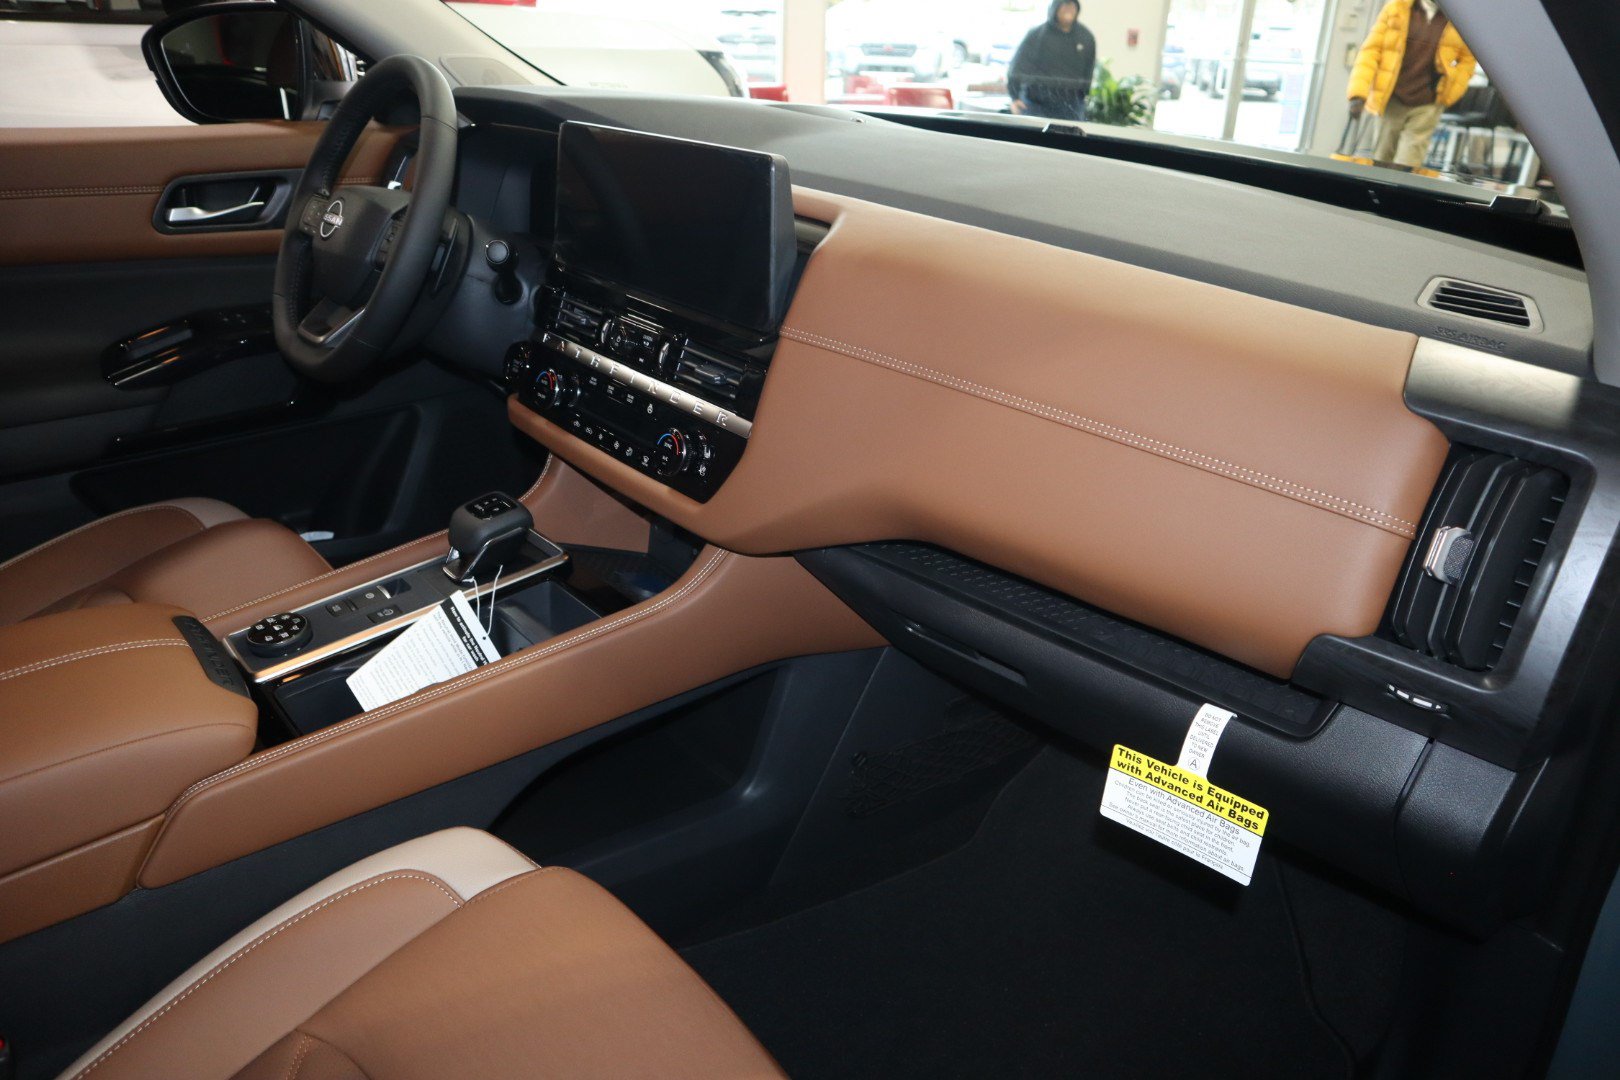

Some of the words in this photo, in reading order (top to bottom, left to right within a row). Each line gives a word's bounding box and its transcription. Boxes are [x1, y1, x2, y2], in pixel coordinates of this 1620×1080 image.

[450, 606, 459, 617] How
[473, 645, 486, 662] Neutral
[470, 650, 480, 662] wash
[1117, 748, 1142, 765] This
[1146, 759, 1189, 785] Vehicle
[1193, 780, 1204, 792] is
[1207, 786, 1264, 821] Equipped
[1117, 759, 1142, 776] with
[1145, 771, 1204, 804] Advanced
[1206, 799, 1225, 814] Air
[1228, 808, 1259, 832] Bags
[1129, 777, 1148, 792] Even
[1151, 788, 1166, 800] with
[1167, 795, 1206, 818] Advanced
[1205, 813, 1217, 824] Air
[1220, 819, 1240, 836] Bags
[1222, 829, 1231, 838] the
